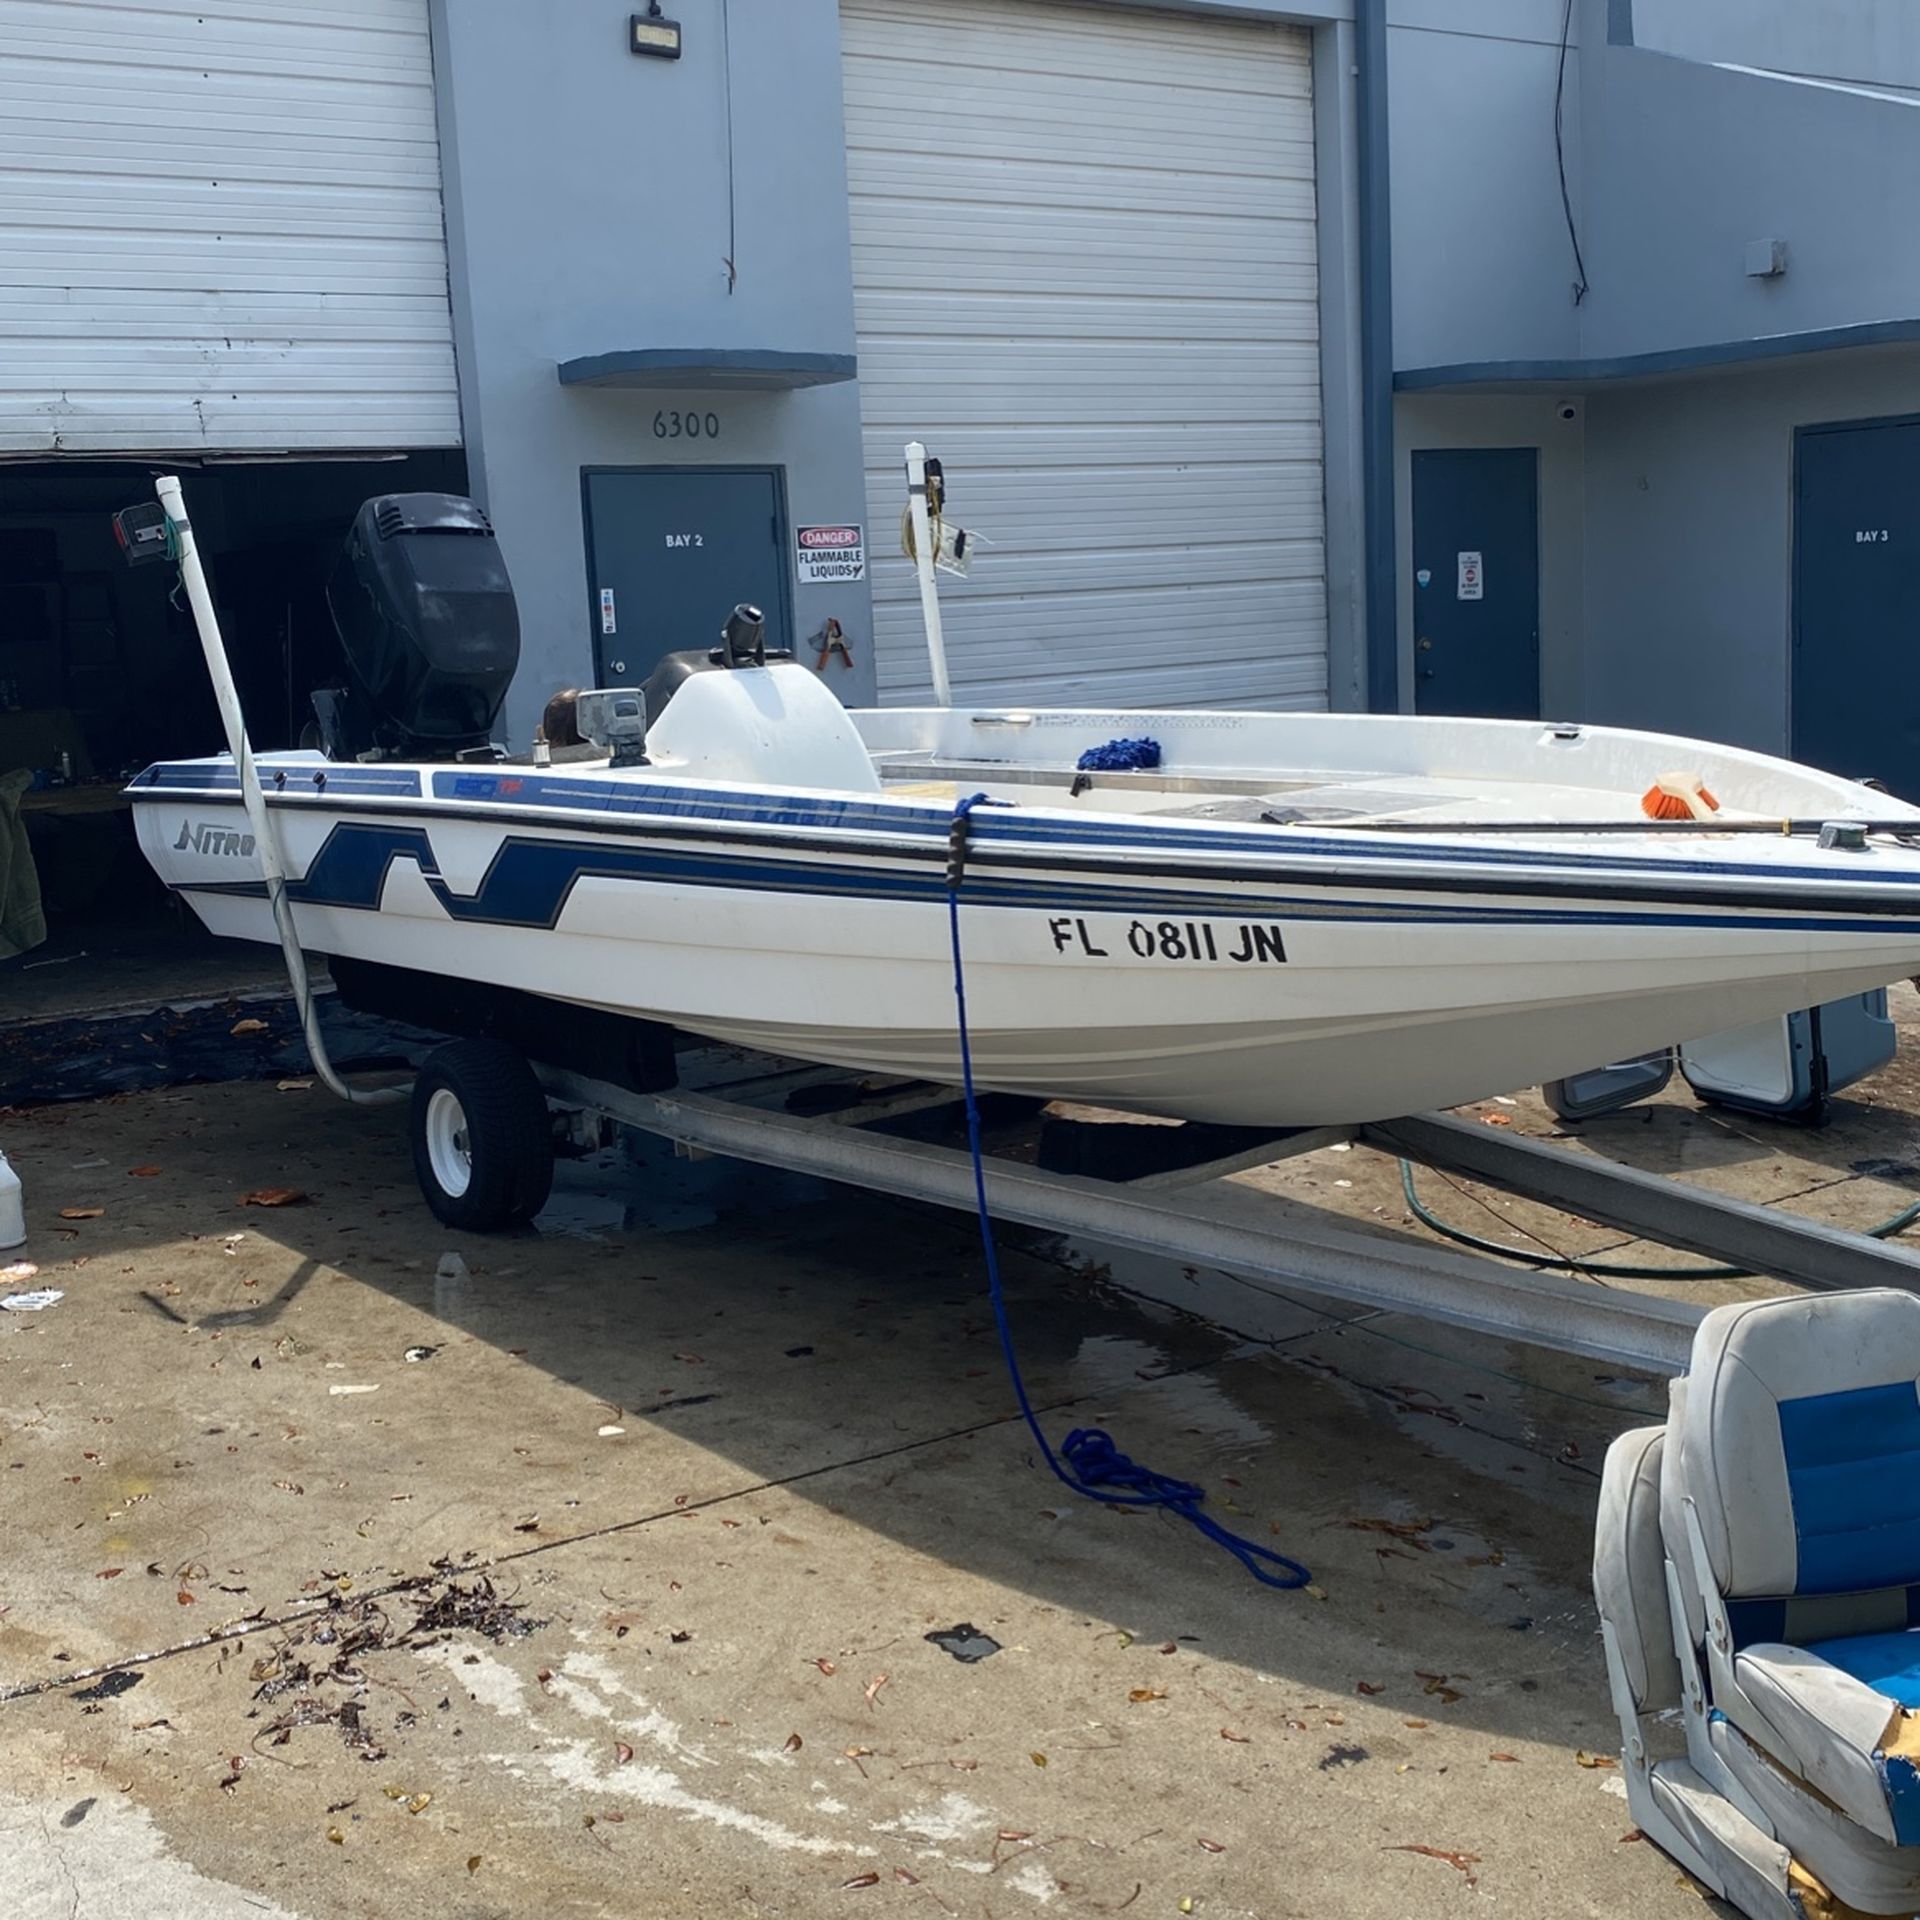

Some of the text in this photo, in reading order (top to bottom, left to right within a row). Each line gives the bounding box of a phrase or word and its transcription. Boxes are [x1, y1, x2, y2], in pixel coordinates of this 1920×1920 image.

[653, 410, 719, 439] 6300
[665, 534, 704, 548] BAY 2
[806, 531, 853, 544] DANGER
[1856, 530, 1888, 543] BAY 3
[798, 550, 863, 564] FLAMMABLE
[810, 564, 853, 579] LIQUIDS
[172, 818, 257, 857] NITRO
[1048, 917, 1288, 963] FL 0811 JN
